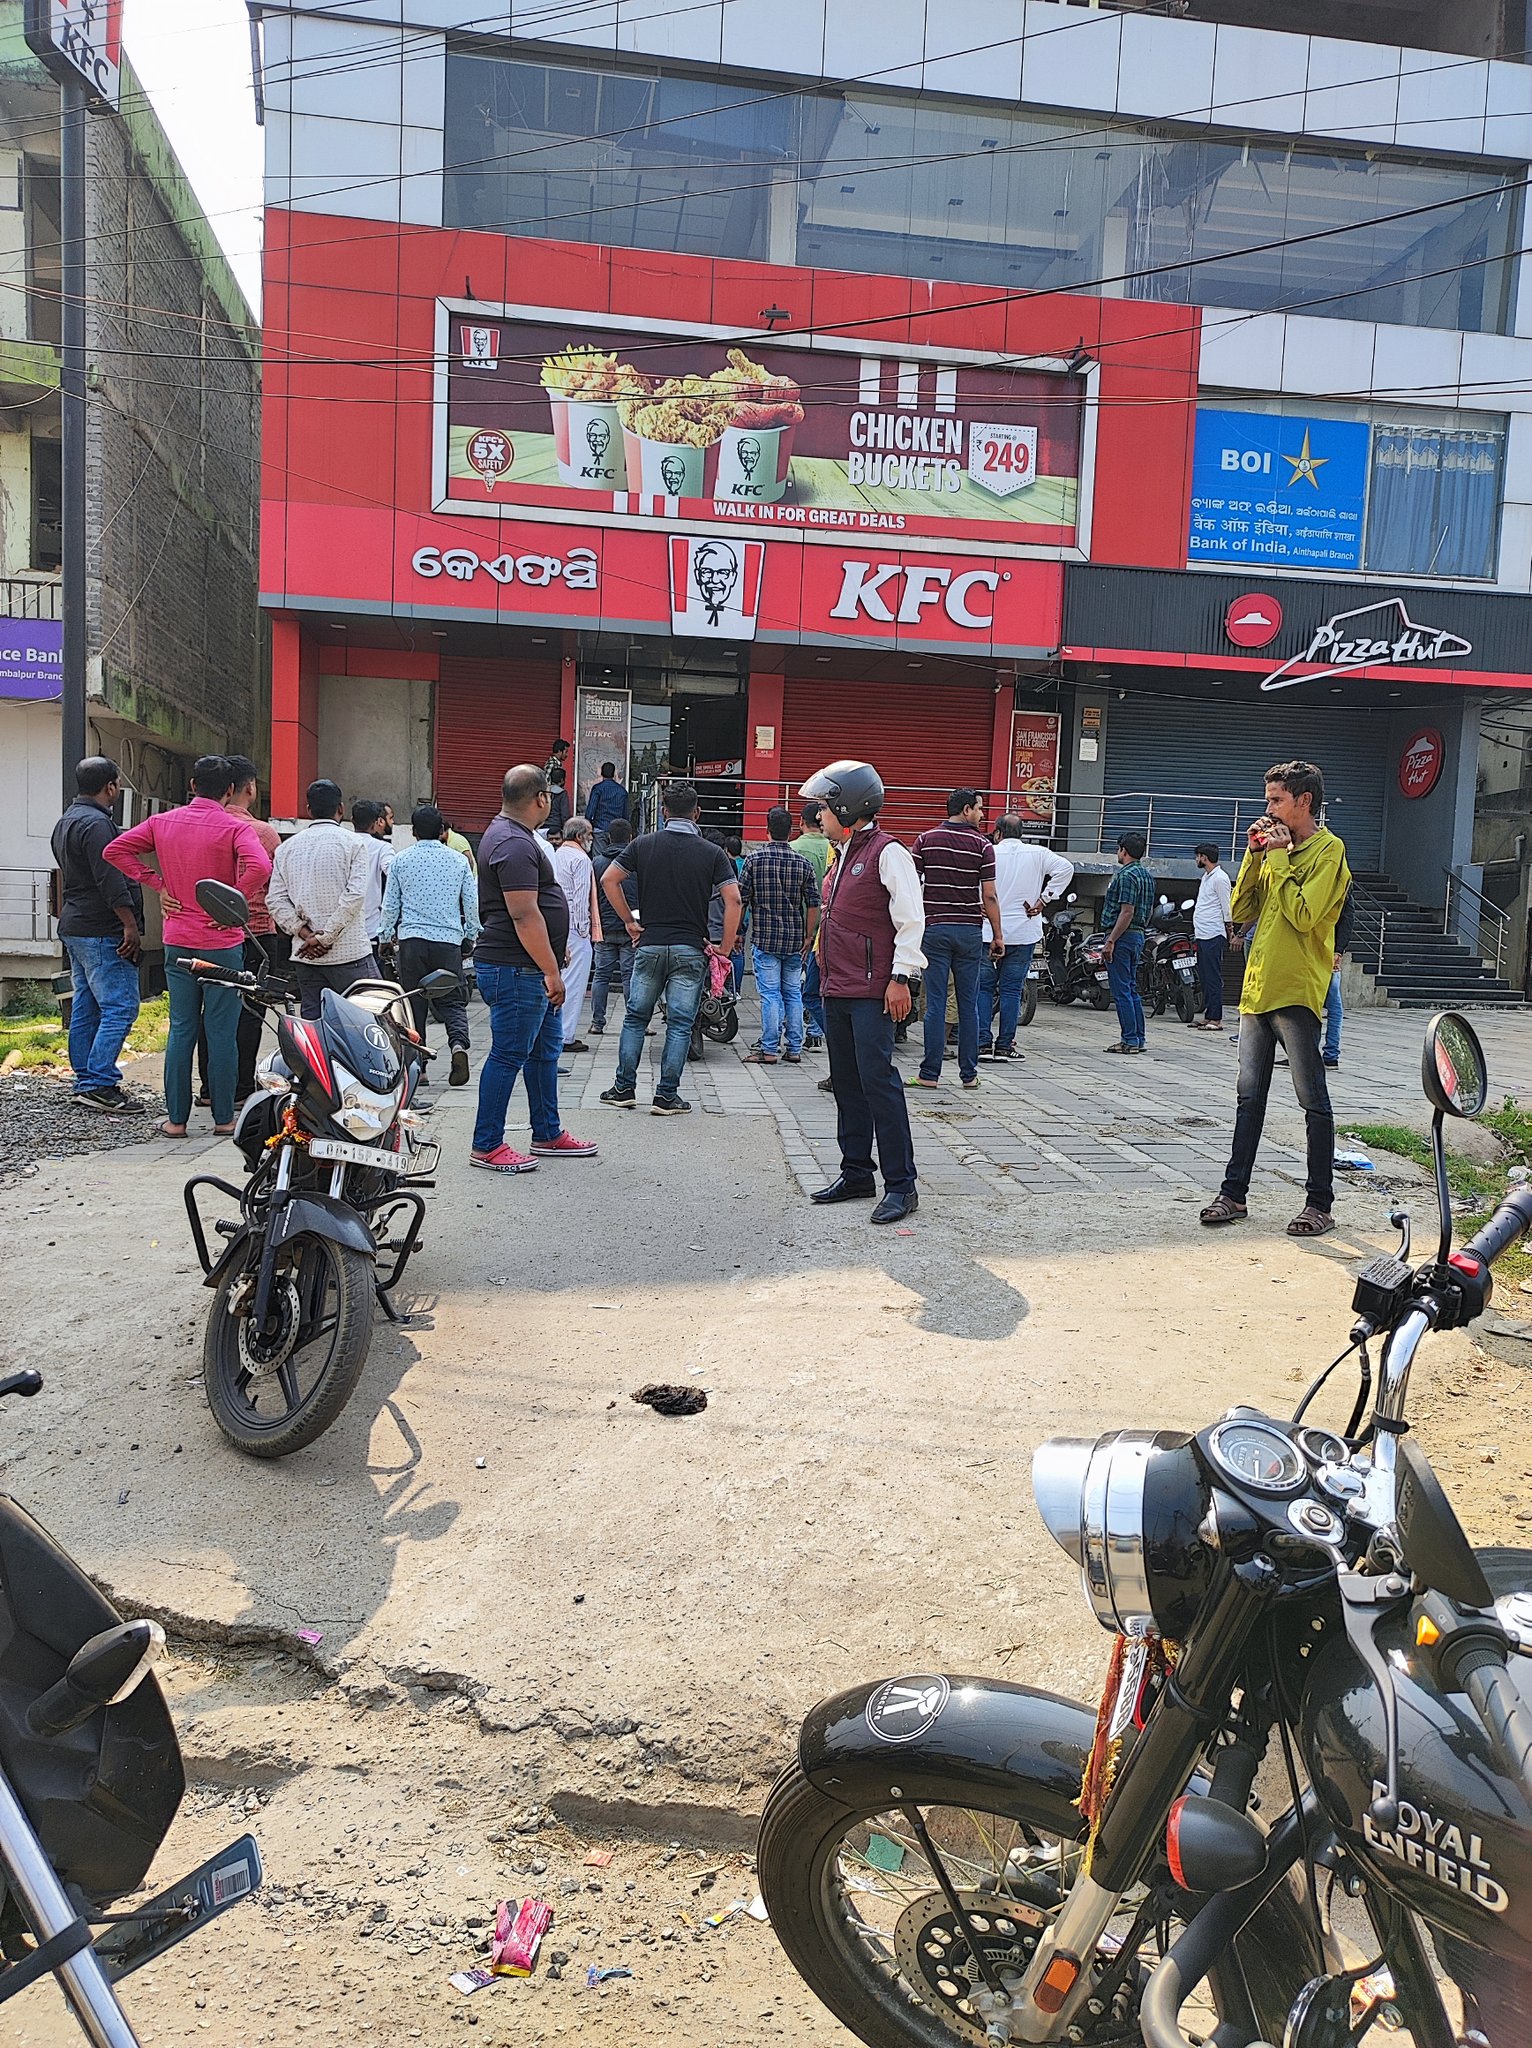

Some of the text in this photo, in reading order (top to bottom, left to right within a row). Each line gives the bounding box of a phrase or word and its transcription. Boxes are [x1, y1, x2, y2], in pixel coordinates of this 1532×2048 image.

[61, 16, 108, 95] KFC
[850, 411, 963, 454] CHICKEN
[473, 442, 505, 460] 5X
[1221, 449, 1271, 474] BOI
[478, 460, 503, 469] SAFETY
[580, 467, 615, 480] KFC
[849, 451, 962, 493] BUCKETS
[731, 483, 763, 496] KFC
[713, 502, 906, 529] WALK IN FOR GREAT DEALS
[1190, 536, 1228, 550] Bank
[1232, 538, 1248, 551] of
[1251, 539, 1291, 556] India,
[1329, 550, 1355, 560] Branch
[829, 560, 1000, 628] KFC
[1305, 626, 1448, 664] Pizza Hut
[586, 699, 622, 707] CHICKEN
[1015, 739, 1031, 747] STYLE
[1405, 753, 1434, 773] Pizza
[1408, 769, 1429, 786] Hut
[1362, 1812, 1510, 1912] ENFIELD
